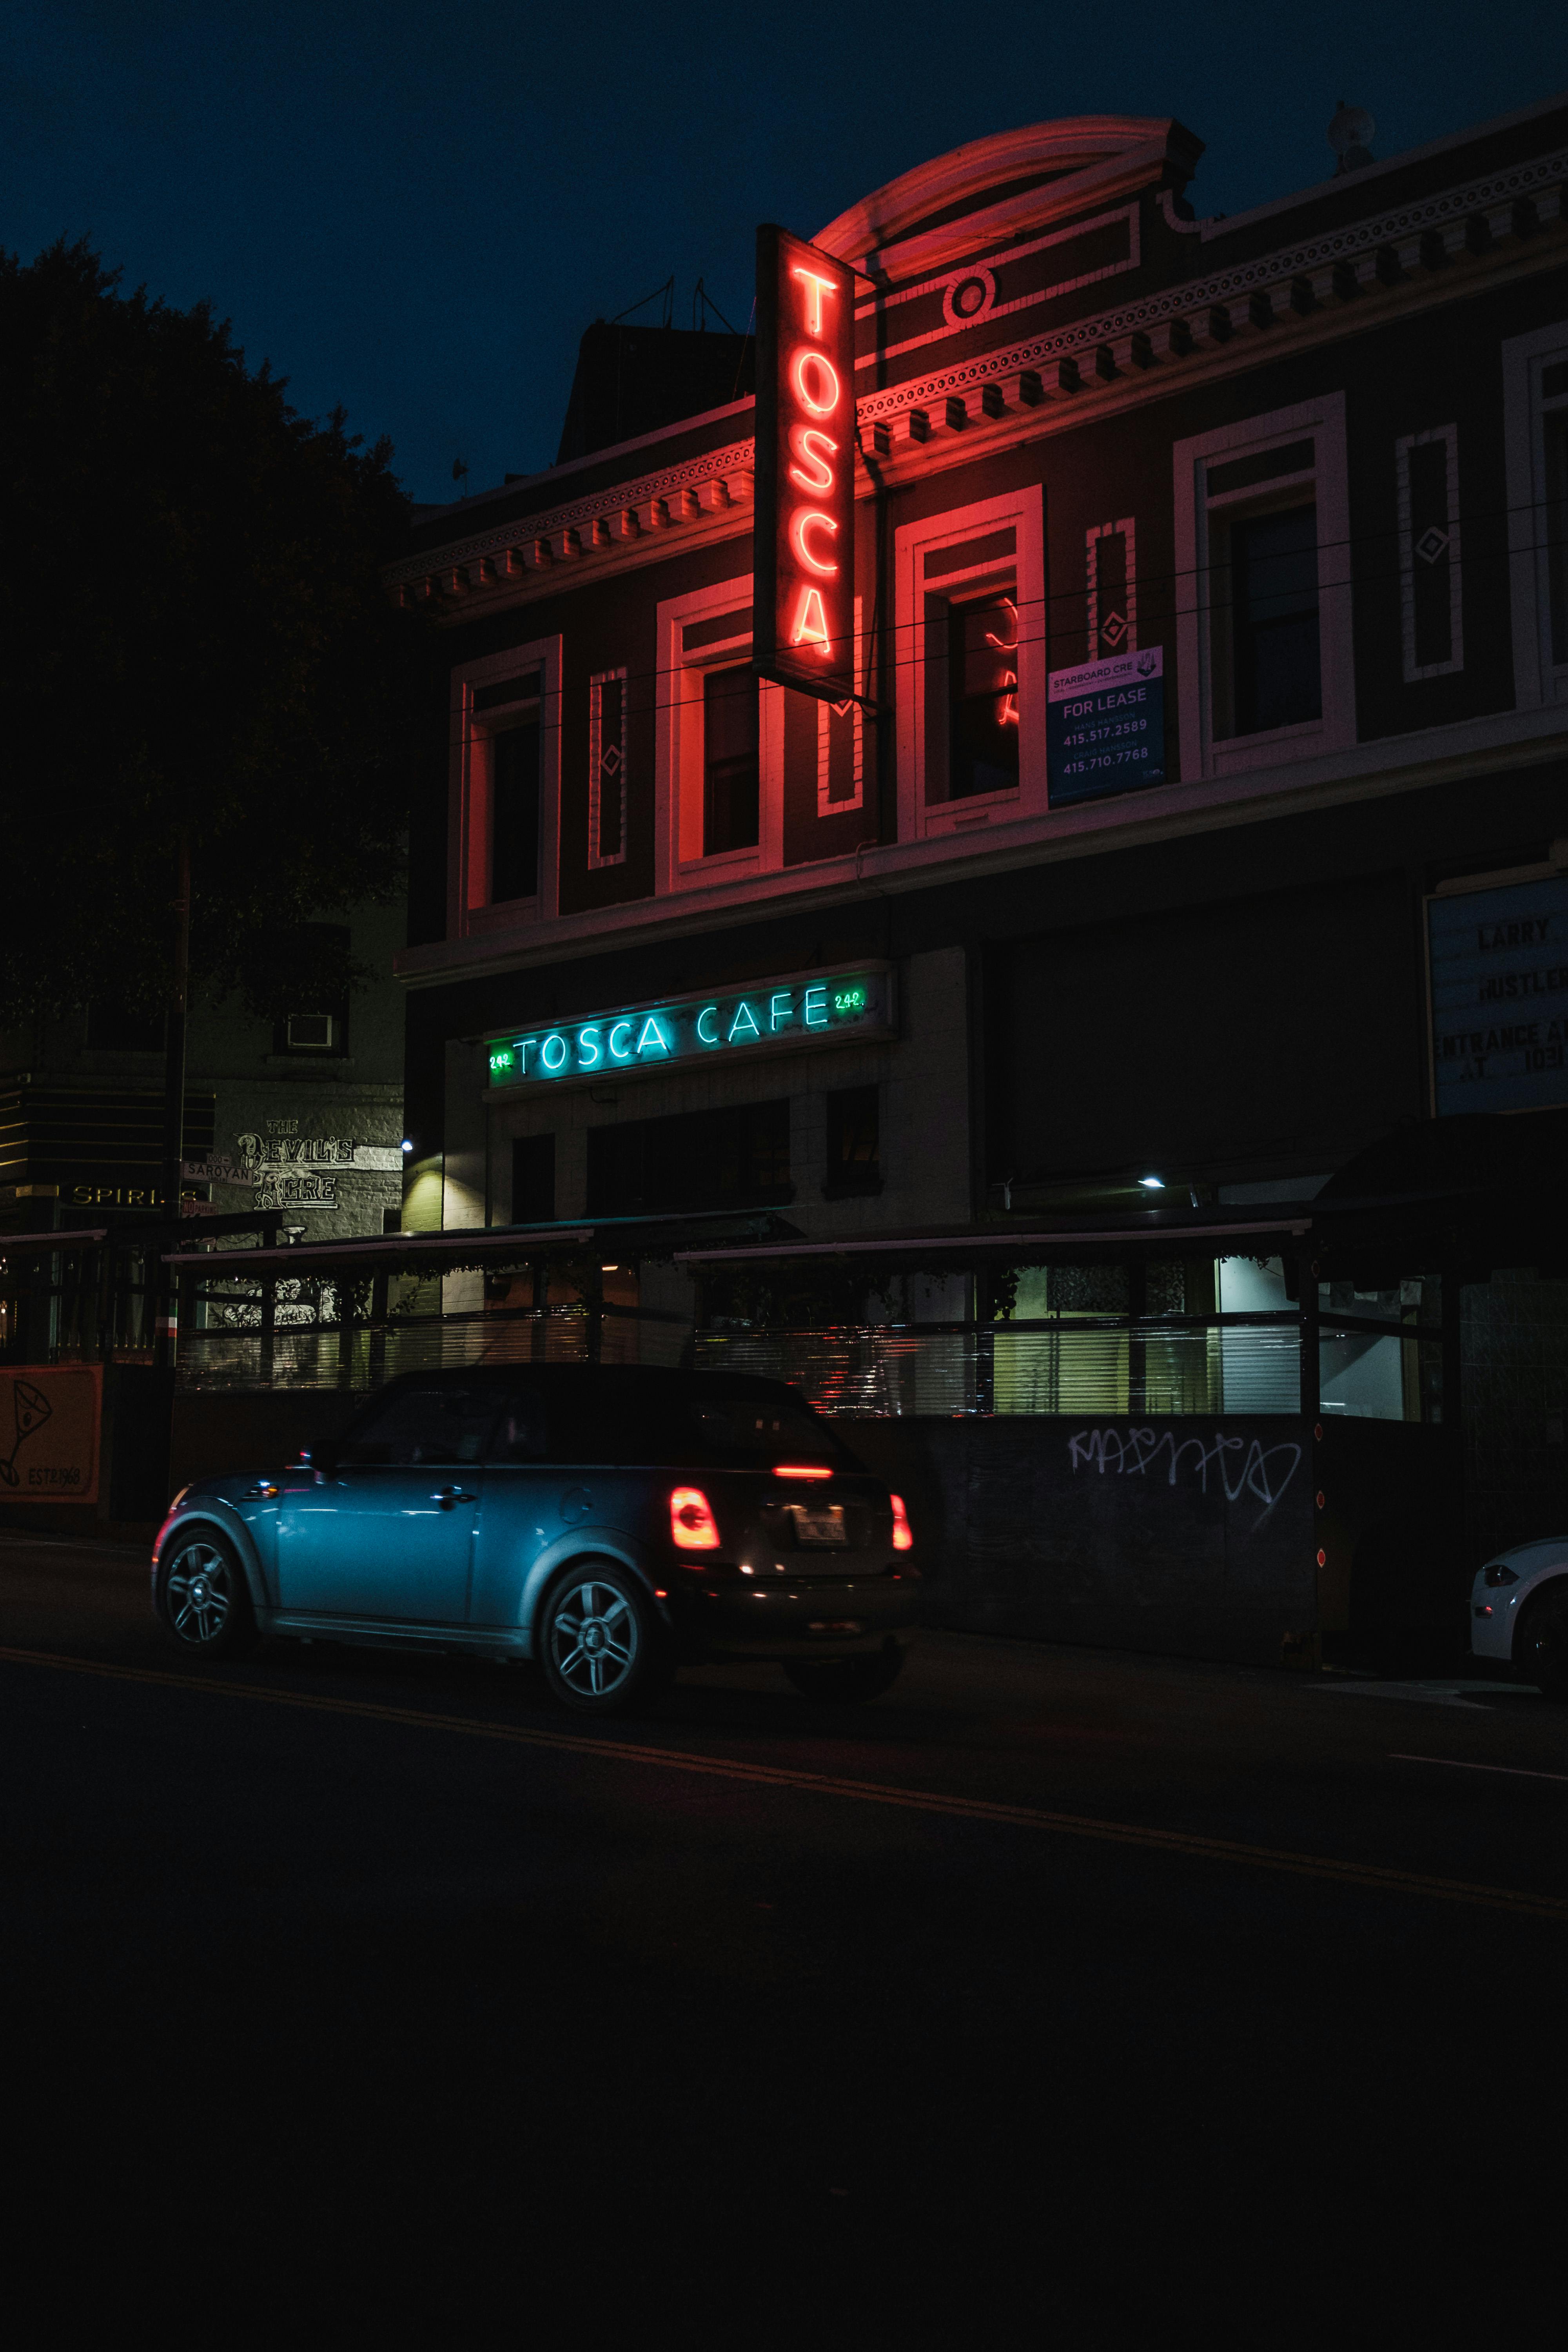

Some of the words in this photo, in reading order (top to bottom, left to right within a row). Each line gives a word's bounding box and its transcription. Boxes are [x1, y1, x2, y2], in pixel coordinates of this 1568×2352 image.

[790, 266, 840, 656] TOSCA
[1053, 667, 1111, 688] STARBOARD
[1113, 661, 1133, 673] CRE
[1063, 700, 1094, 719] FOR
[1097, 687, 1147, 711] LEASE
[1063, 719, 1147, 746] 415.517.2589
[1063, 747, 1148, 775] 415.710.7768
[1477, 918, 1549, 950] LARRY
[489, 1053, 511, 1069] 242
[512, 1018, 667, 1074] TOSCA
[697, 987, 828, 1043] CAFE
[267, 1120, 298, 1134] THE
[188, 1163, 249, 1180] SAROYAN
[72, 1185, 196, 1205] SPIRIS
